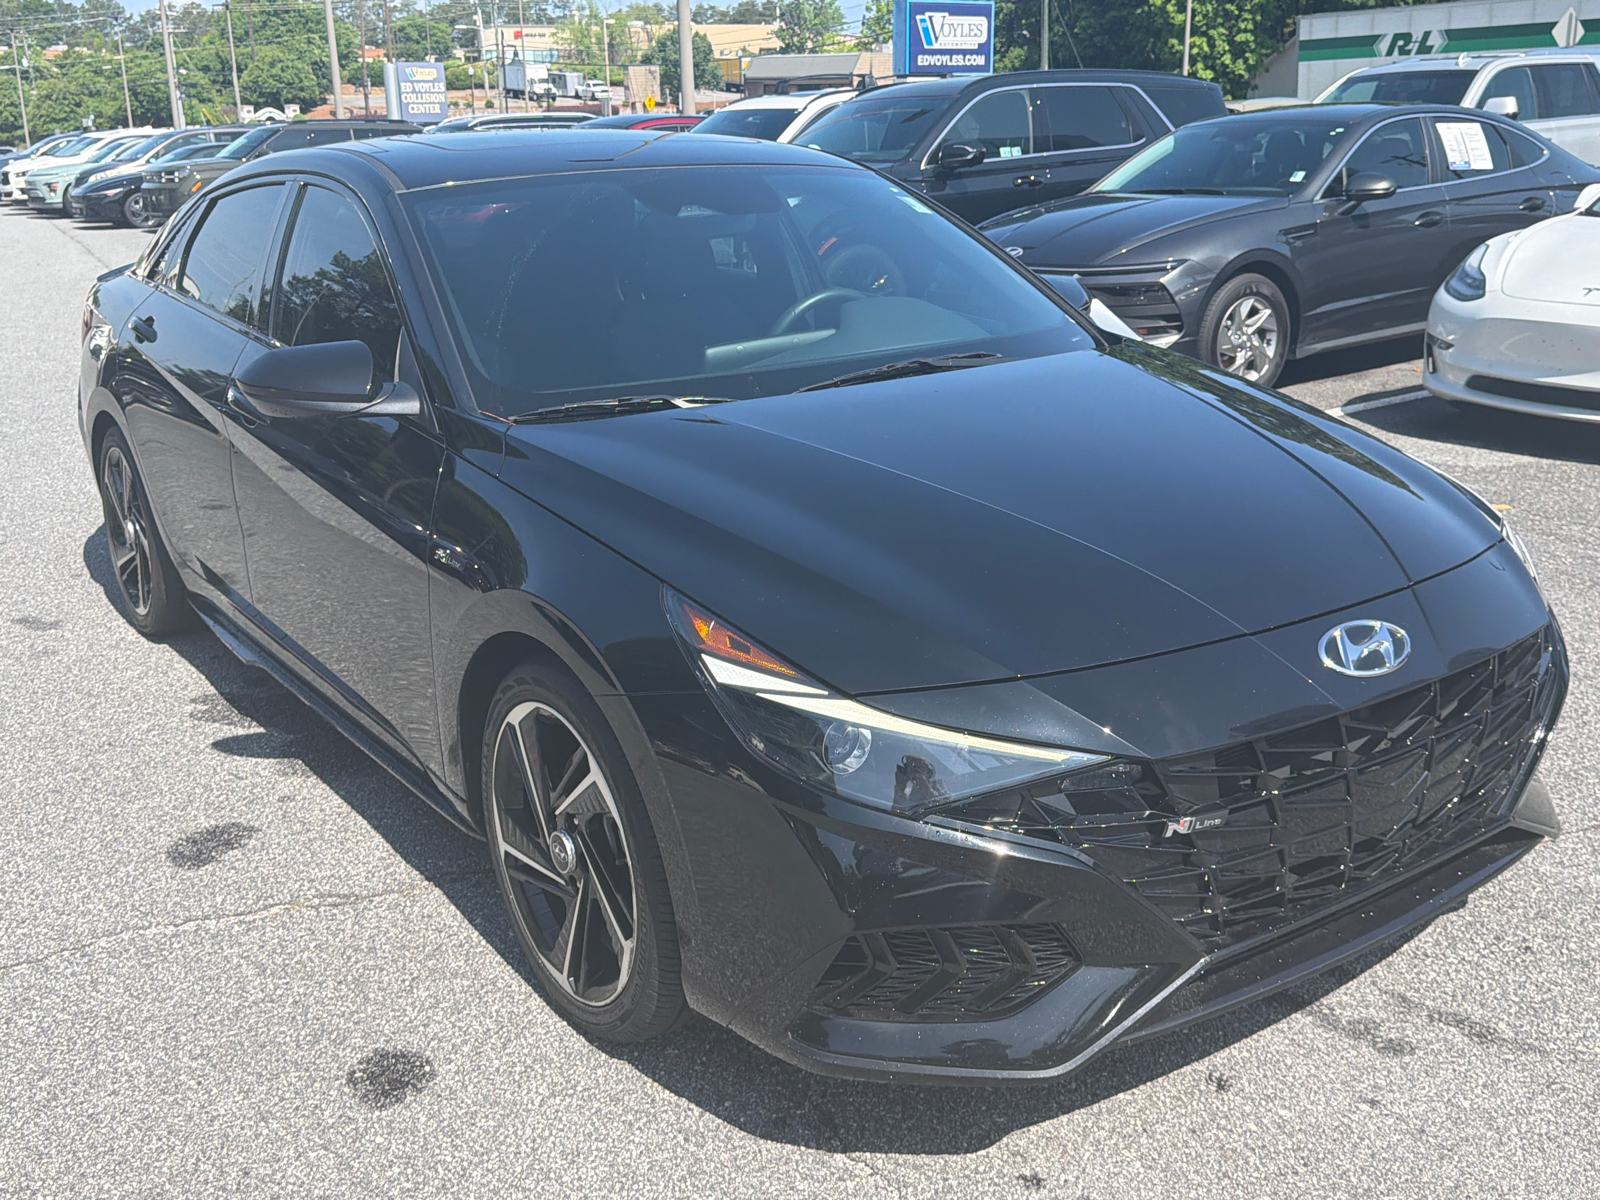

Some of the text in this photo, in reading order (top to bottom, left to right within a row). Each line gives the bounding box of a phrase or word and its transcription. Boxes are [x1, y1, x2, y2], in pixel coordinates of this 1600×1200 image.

[928, 15, 983, 43] VOYLES
[917, 54, 985, 66] EDVOYLES.COM
[400, 82, 445, 92] ED VOYLES
[401, 93, 446, 103] COLLISION
[408, 104, 441, 114] CENTER
